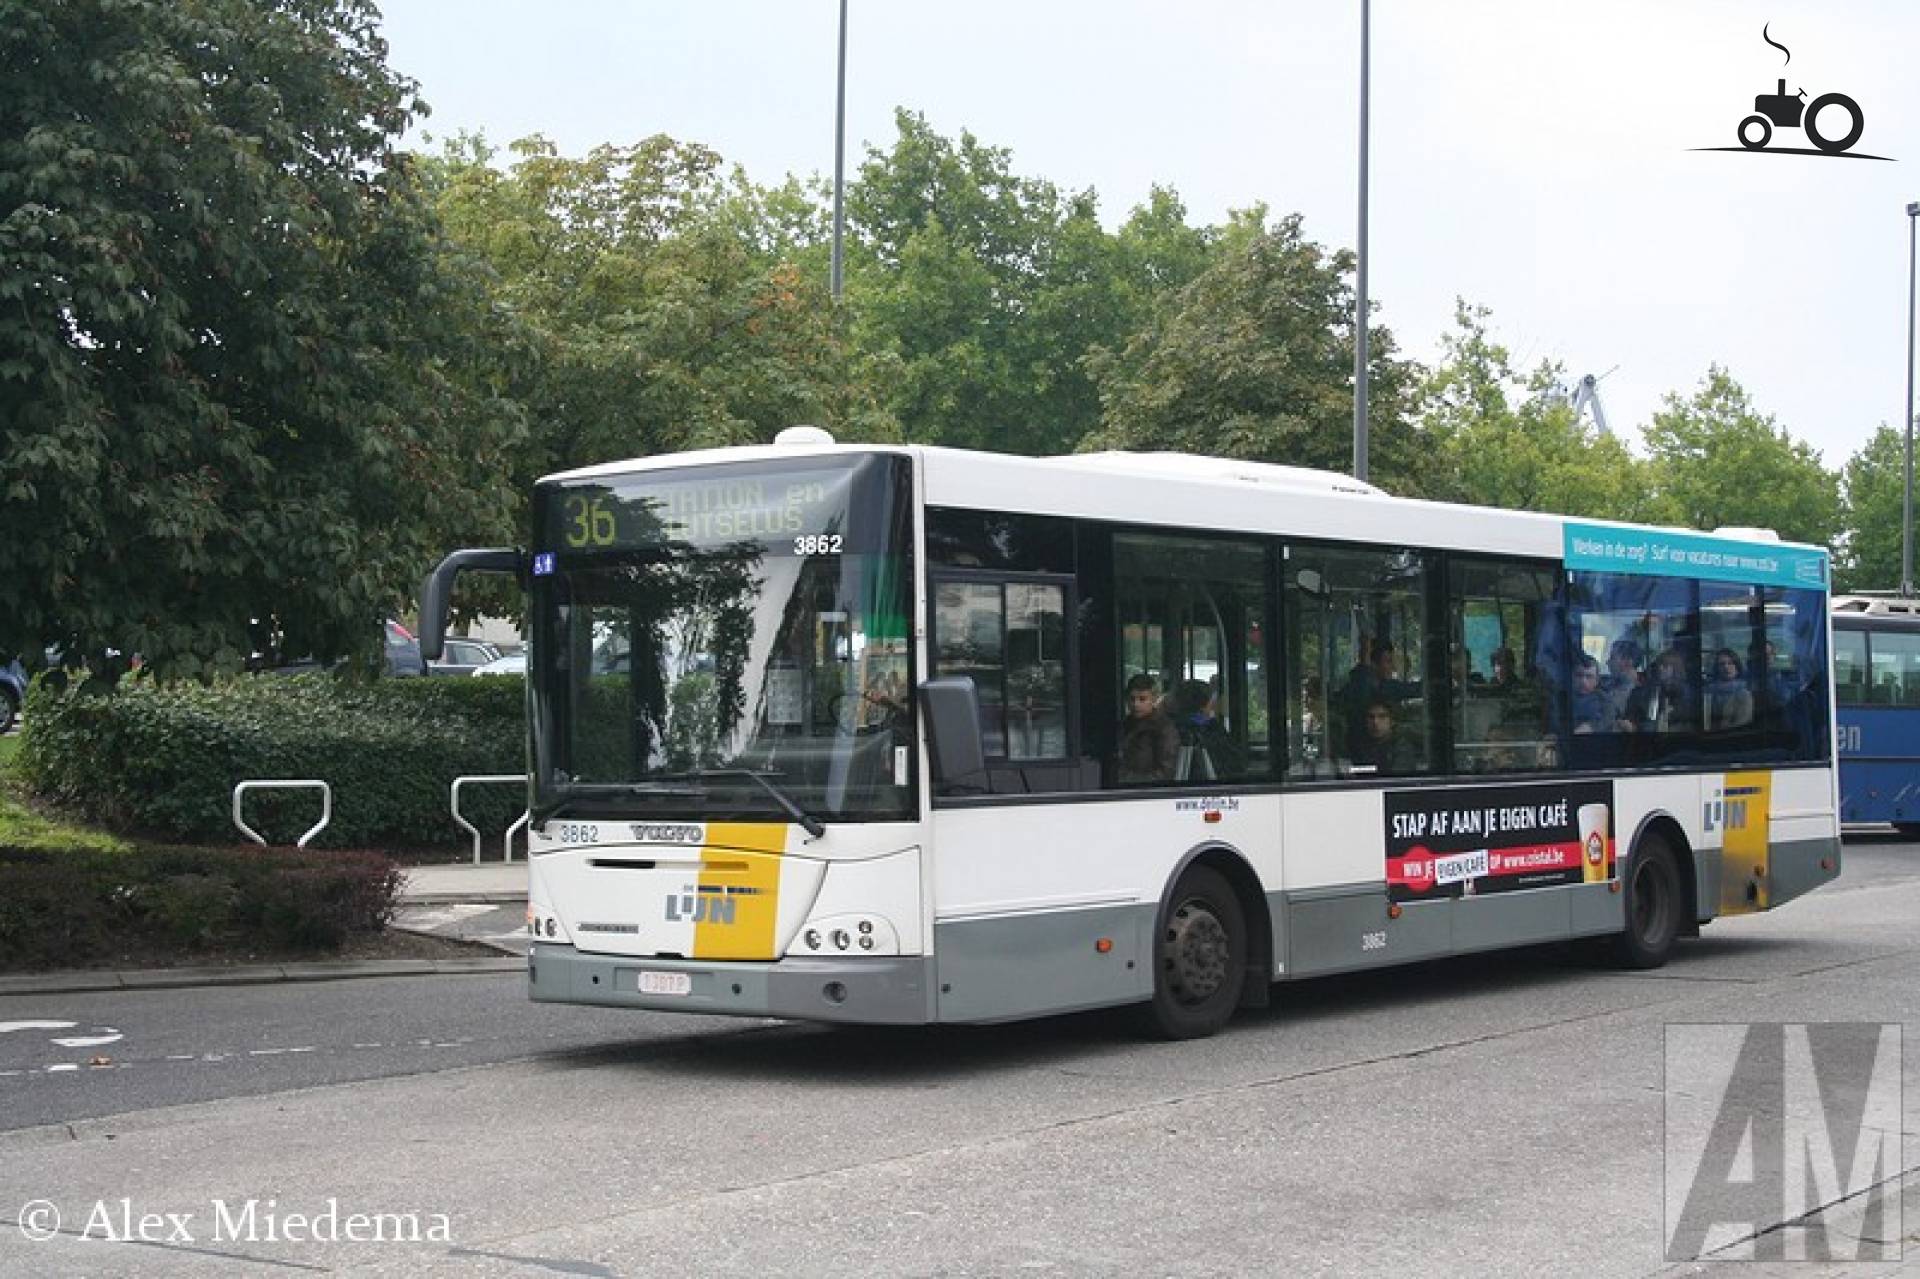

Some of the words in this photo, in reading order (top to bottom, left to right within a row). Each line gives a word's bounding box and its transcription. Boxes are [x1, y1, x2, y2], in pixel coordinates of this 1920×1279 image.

[786, 483, 824, 506] en
[566, 496, 616, 547] 36
[793, 535, 843, 555] 3862
[1393, 813, 1427, 838] STAP
[1430, 811, 1449, 836] AF
[1452, 809, 1483, 834] AAN
[1483, 808, 1496, 838] JE
[1500, 806, 1537, 831] EIGEN
[1540, 798, 1568, 828] CAFÉ
[560, 824, 599, 843] 3862
[630, 824, 703, 842] VOLVO
[1403, 863, 1421, 878] WIN
